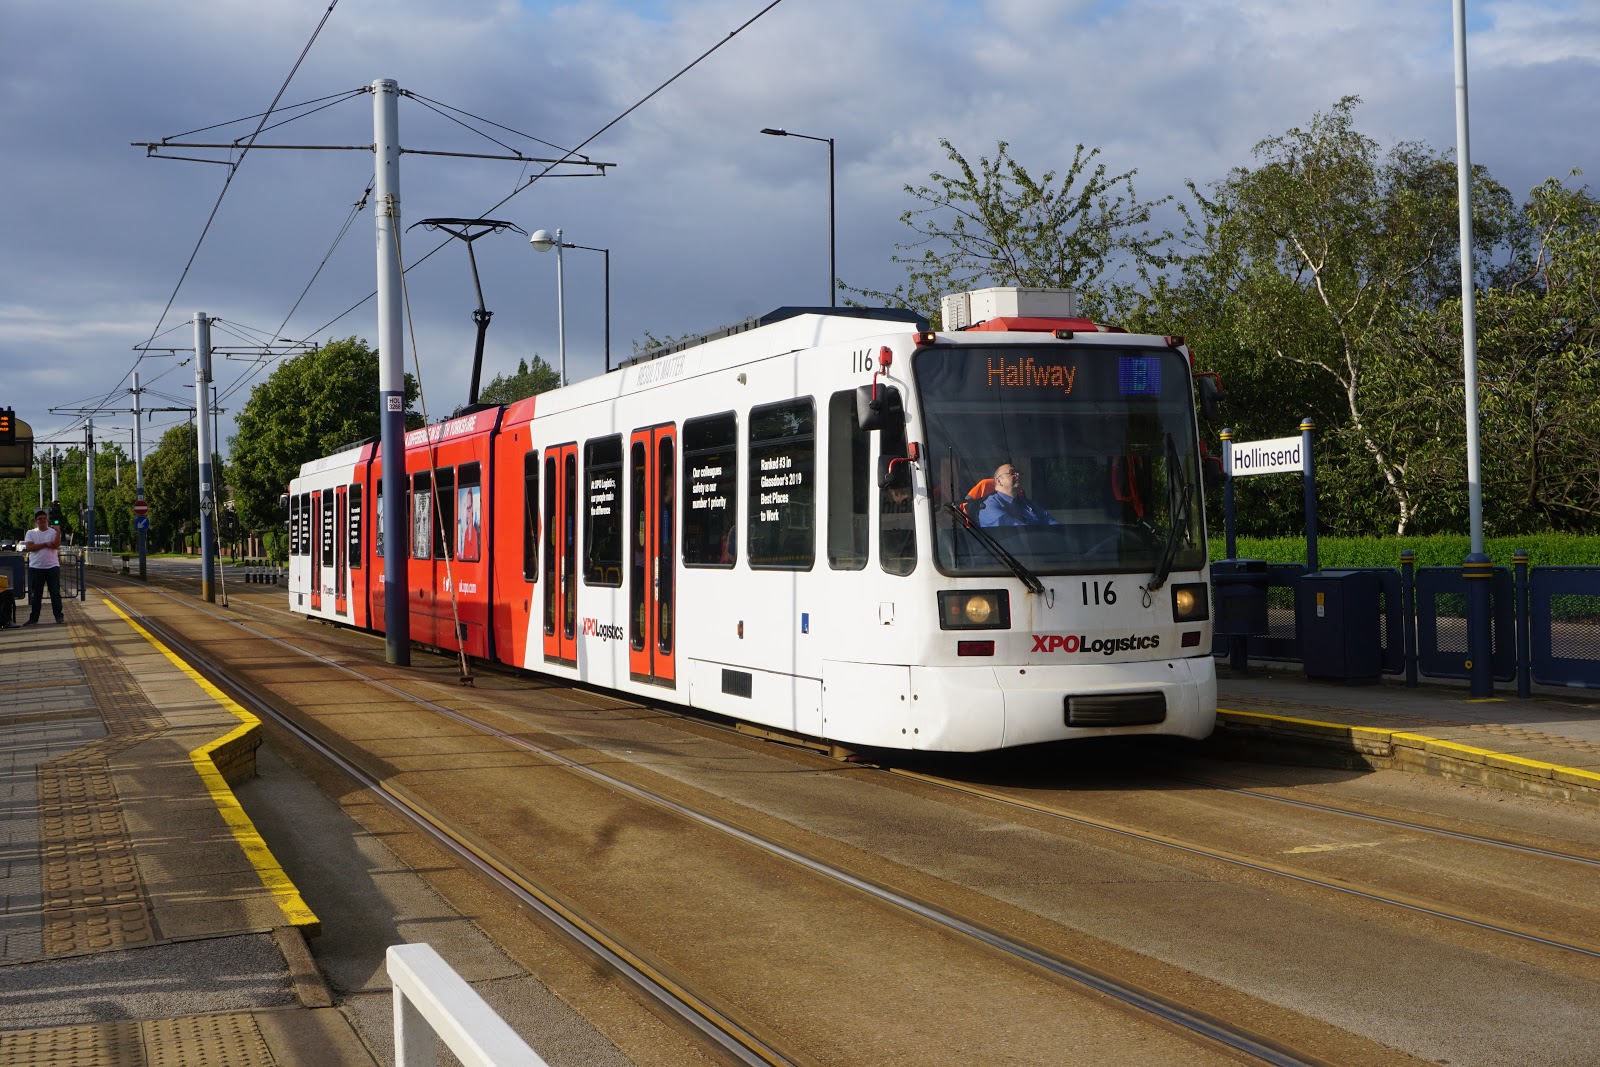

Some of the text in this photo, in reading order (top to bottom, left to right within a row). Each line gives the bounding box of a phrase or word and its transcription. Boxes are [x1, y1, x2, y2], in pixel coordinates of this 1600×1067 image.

[660, 354, 686, 381] MATTER
[852, 348, 873, 373] 116
[988, 357, 1076, 394] Halfway
[760, 455, 792, 471] Ranked #3 in
[1234, 443, 1301, 470] Hollinsend
[692, 465, 722, 479] Our colleagues
[760, 472, 802, 488] Glassdoor's 2019
[692, 482, 705, 496] safety
[201, 501, 213, 510] 40
[692, 497, 708, 509] number
[710, 495, 727, 511] priority
[760, 491, 789, 505] Best Places
[760, 508, 780, 522] to Work
[1082, 580, 1117, 606] 116
